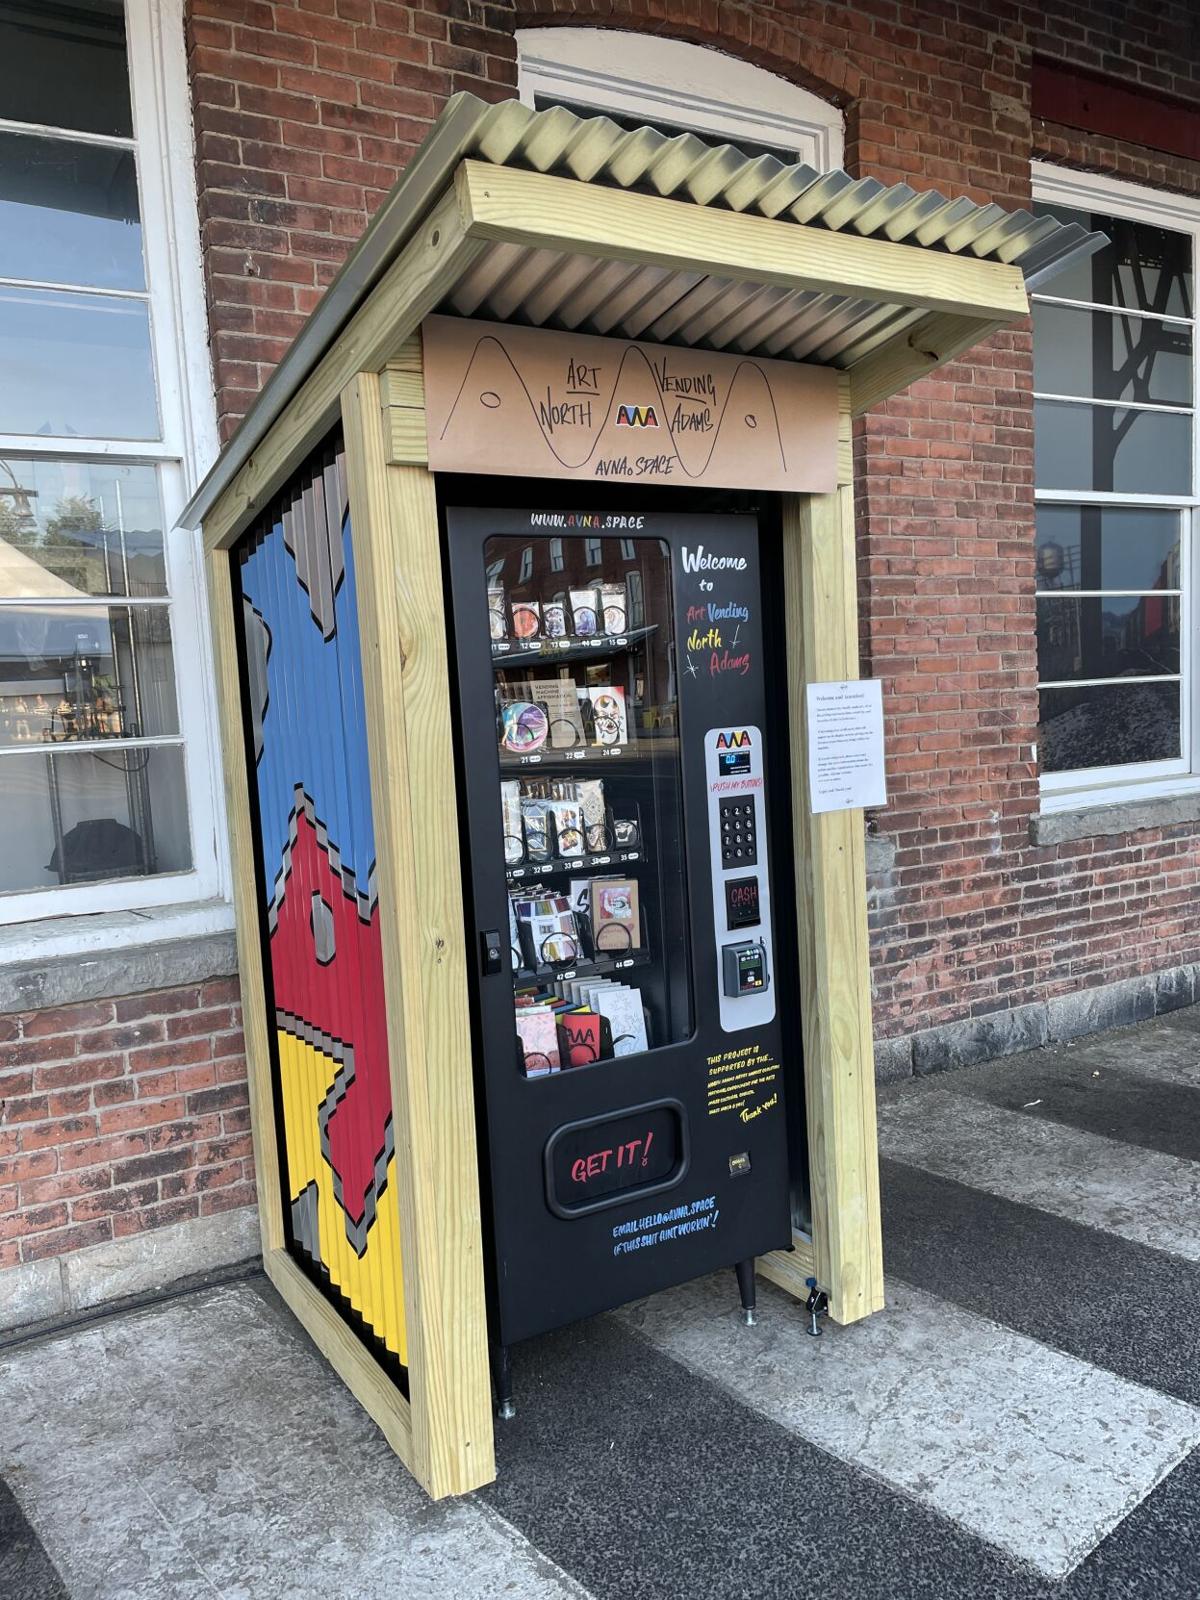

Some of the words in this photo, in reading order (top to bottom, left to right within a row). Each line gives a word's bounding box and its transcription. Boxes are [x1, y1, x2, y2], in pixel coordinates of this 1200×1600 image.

[566, 358, 601, 389] ART
[655, 357, 718, 406] VENDING
[540, 386, 592, 434] NORTH
[672, 403, 714, 434] ADAMS
[530, 513, 644, 530] WWW.AVNA.SPACE
[682, 545, 748, 574] Welcome
[699, 578, 714, 592] to
[687, 604, 706, 624] Art
[708, 602, 749, 626] Vending
[687, 628, 722, 652] North
[710, 651, 750, 677] Adams
[746, 806, 750, 814] 3
[736, 835, 740, 843] 8
[731, 886, 757, 903] CASH
[707, 1054, 721, 1065] THIS
[723, 1047, 752, 1060] PROJECT
[709, 1060, 746, 1076] SUPPORTED
[746, 1058, 756, 1067] BY
[740, 1106, 762, 1124] Thank
[571, 1149, 613, 1183] GET
[612, 1220, 638, 1238] EMAIL
[614, 1243, 622, 1256] IF
[622, 1237, 640, 1254] THIS
[640, 1232, 659, 1247] SHIT
